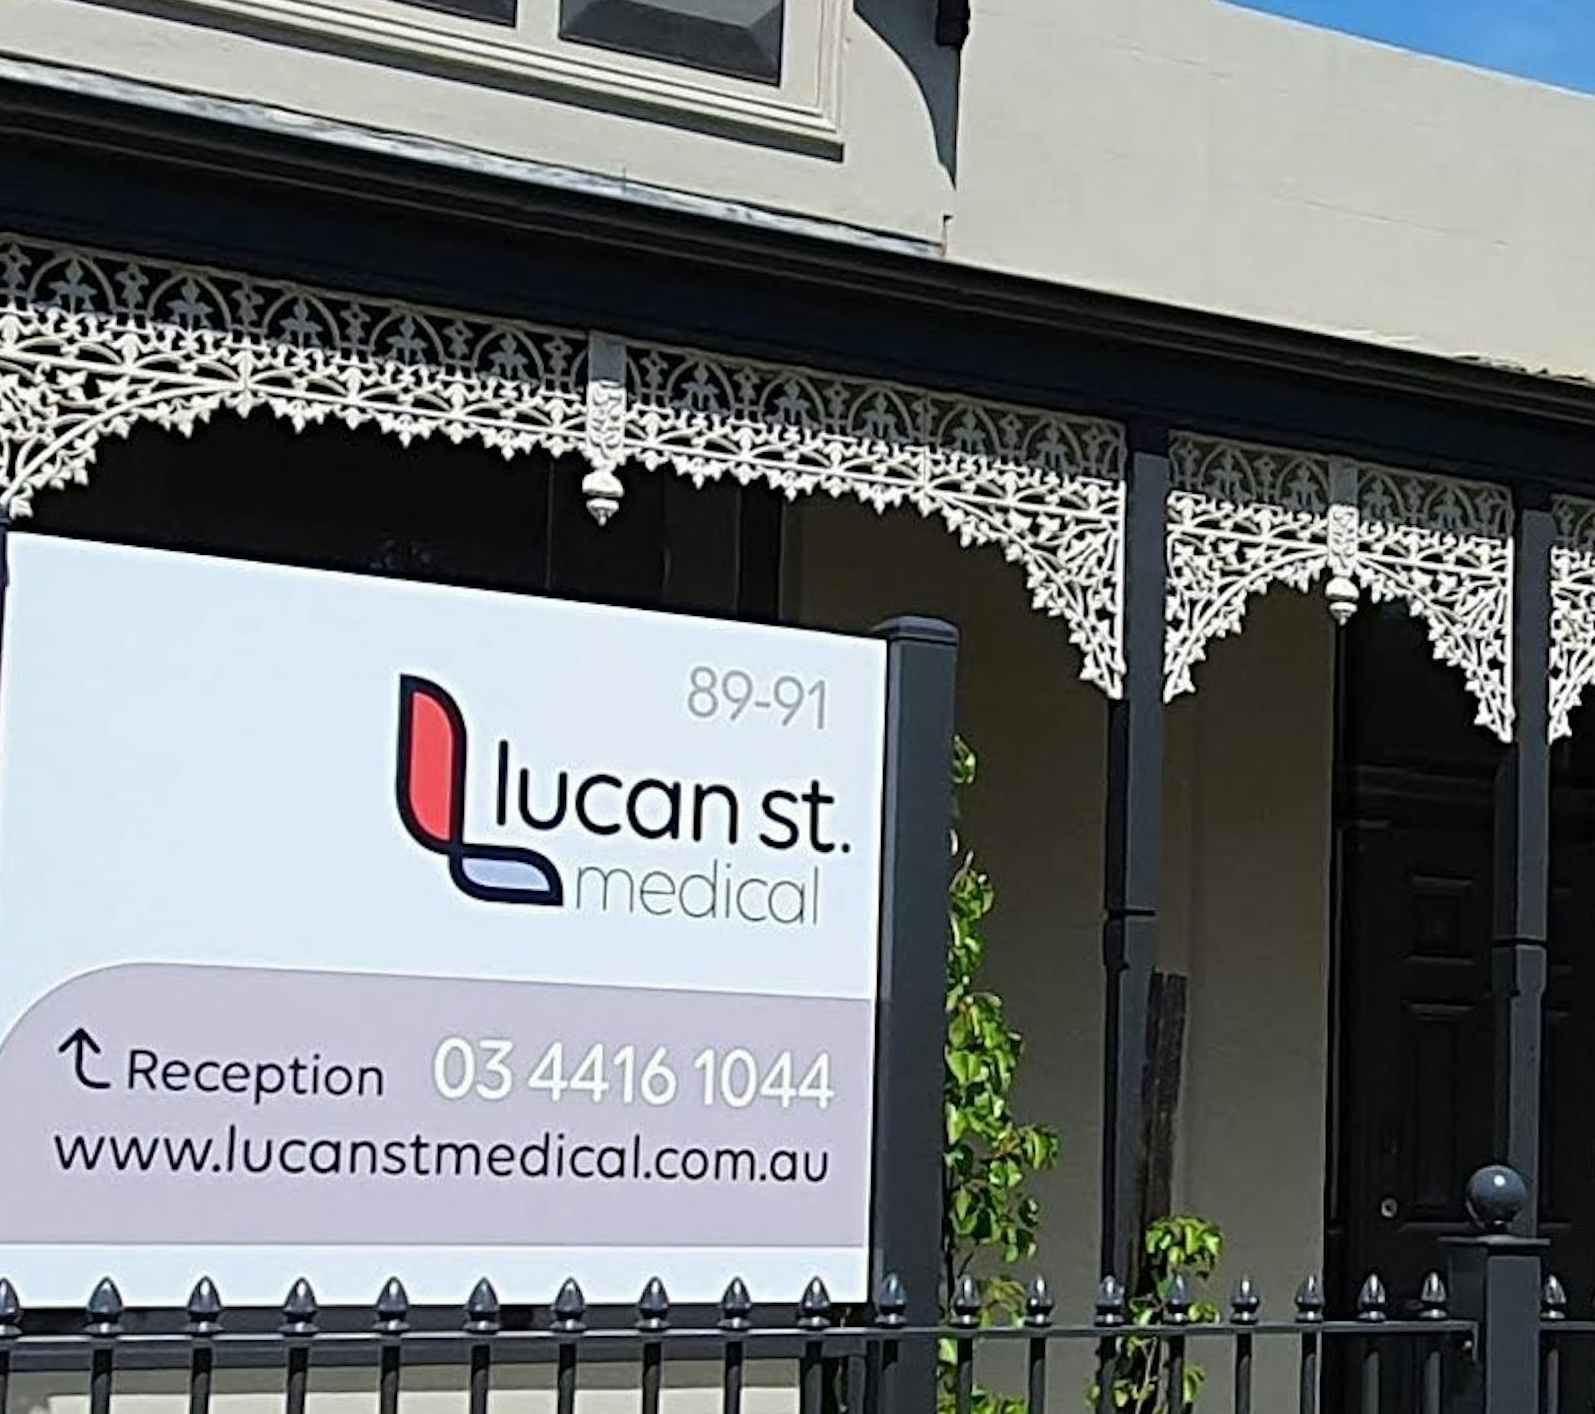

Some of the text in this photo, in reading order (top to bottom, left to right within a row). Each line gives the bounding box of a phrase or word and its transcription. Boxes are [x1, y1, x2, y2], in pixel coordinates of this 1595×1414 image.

[686, 666, 827, 730] 89-91
[494, 739, 852, 855] lucan st.
[576, 858, 820, 926] medical
[125, 1046, 387, 1107] Reception
[433, 1035, 836, 1111] 03 4416 1044
[52, 1124, 832, 1186] www.lucanstmedical.com.au
